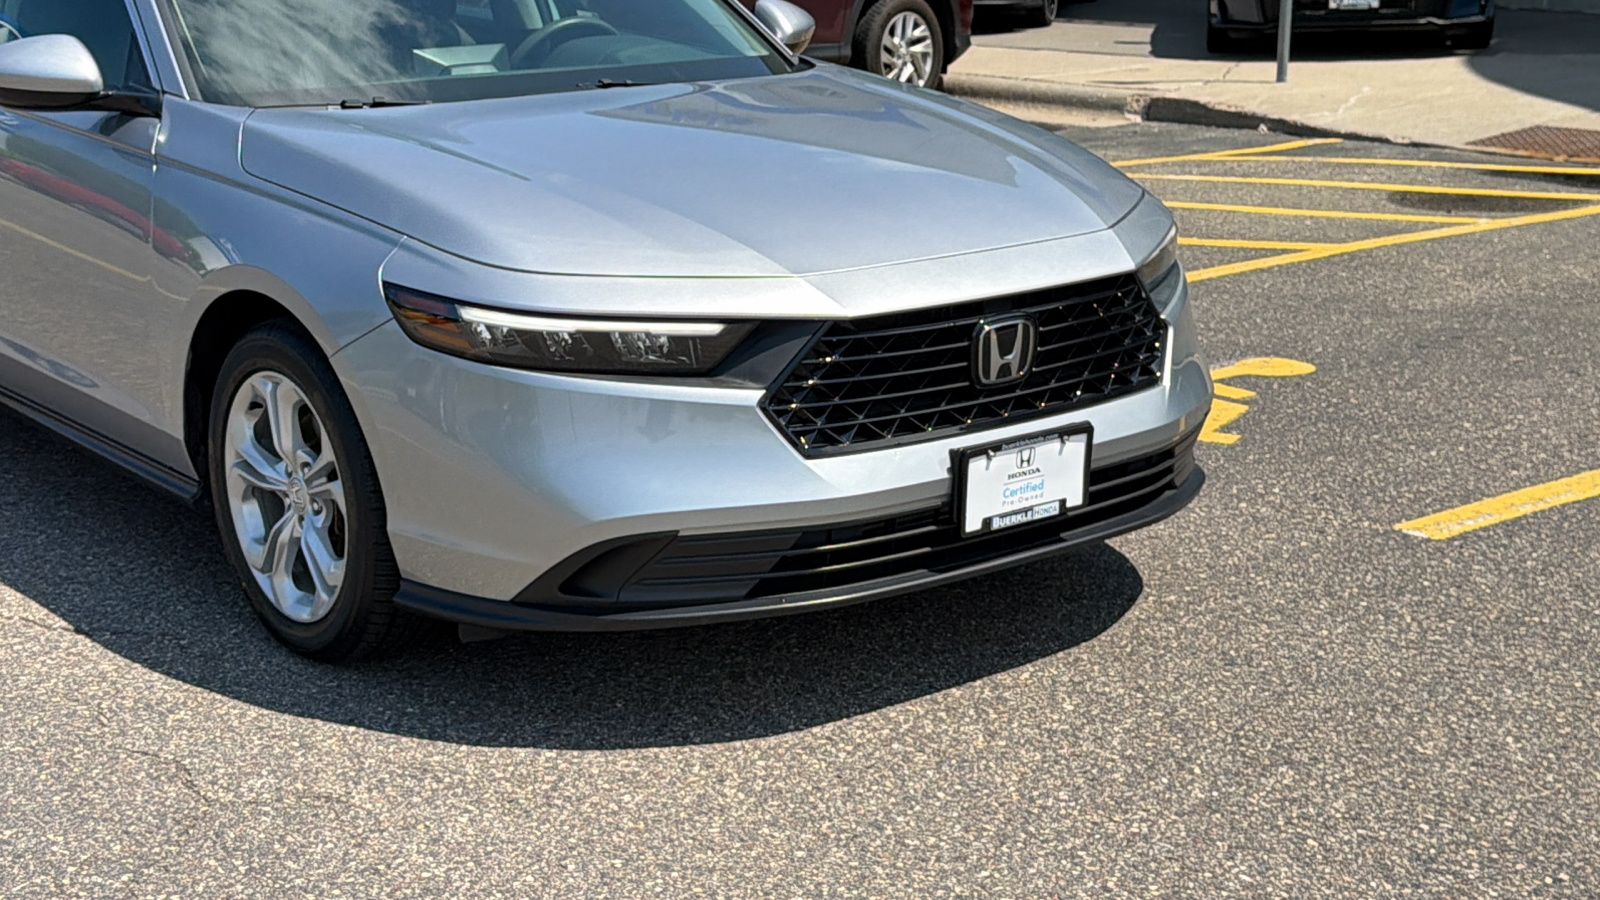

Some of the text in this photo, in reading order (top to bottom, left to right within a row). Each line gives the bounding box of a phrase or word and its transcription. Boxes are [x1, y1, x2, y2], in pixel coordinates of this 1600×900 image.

[1007, 467, 1041, 480] HONDA
[1002, 479, 1044, 499] Certified
[1002, 492, 1044, 507] Pre-Owned
